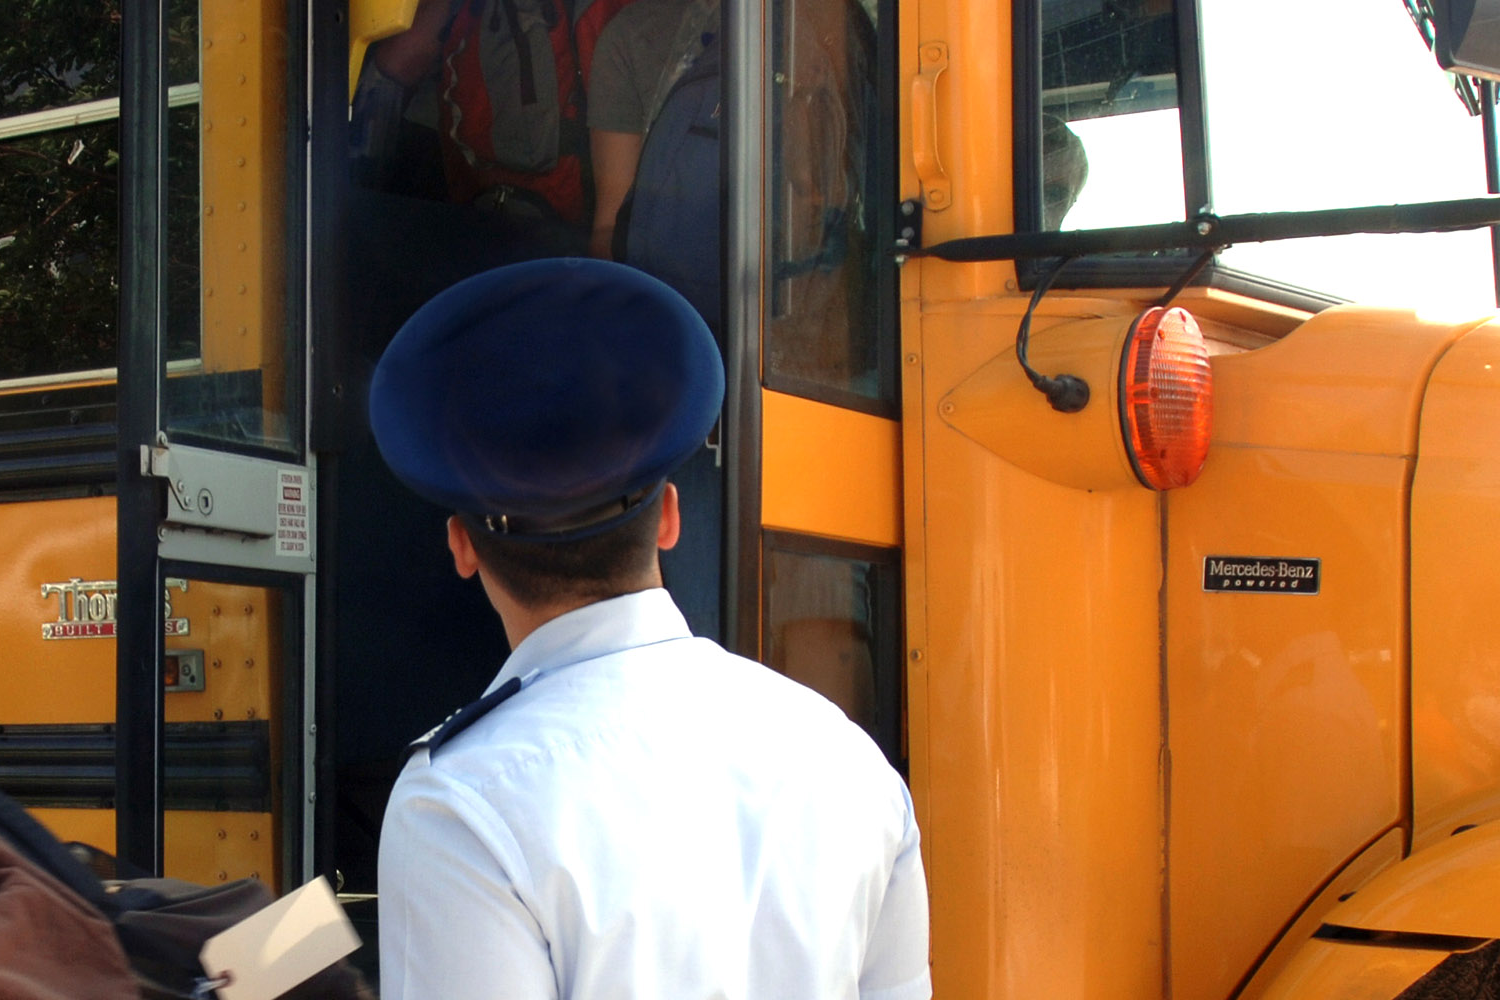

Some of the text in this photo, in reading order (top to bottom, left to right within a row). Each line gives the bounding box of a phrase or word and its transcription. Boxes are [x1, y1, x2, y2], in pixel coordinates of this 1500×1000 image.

[1210, 560, 1314, 578] Mercedes-Benz
[1223, 579, 1299, 588] powered
[54, 623, 104, 637] BUILT
